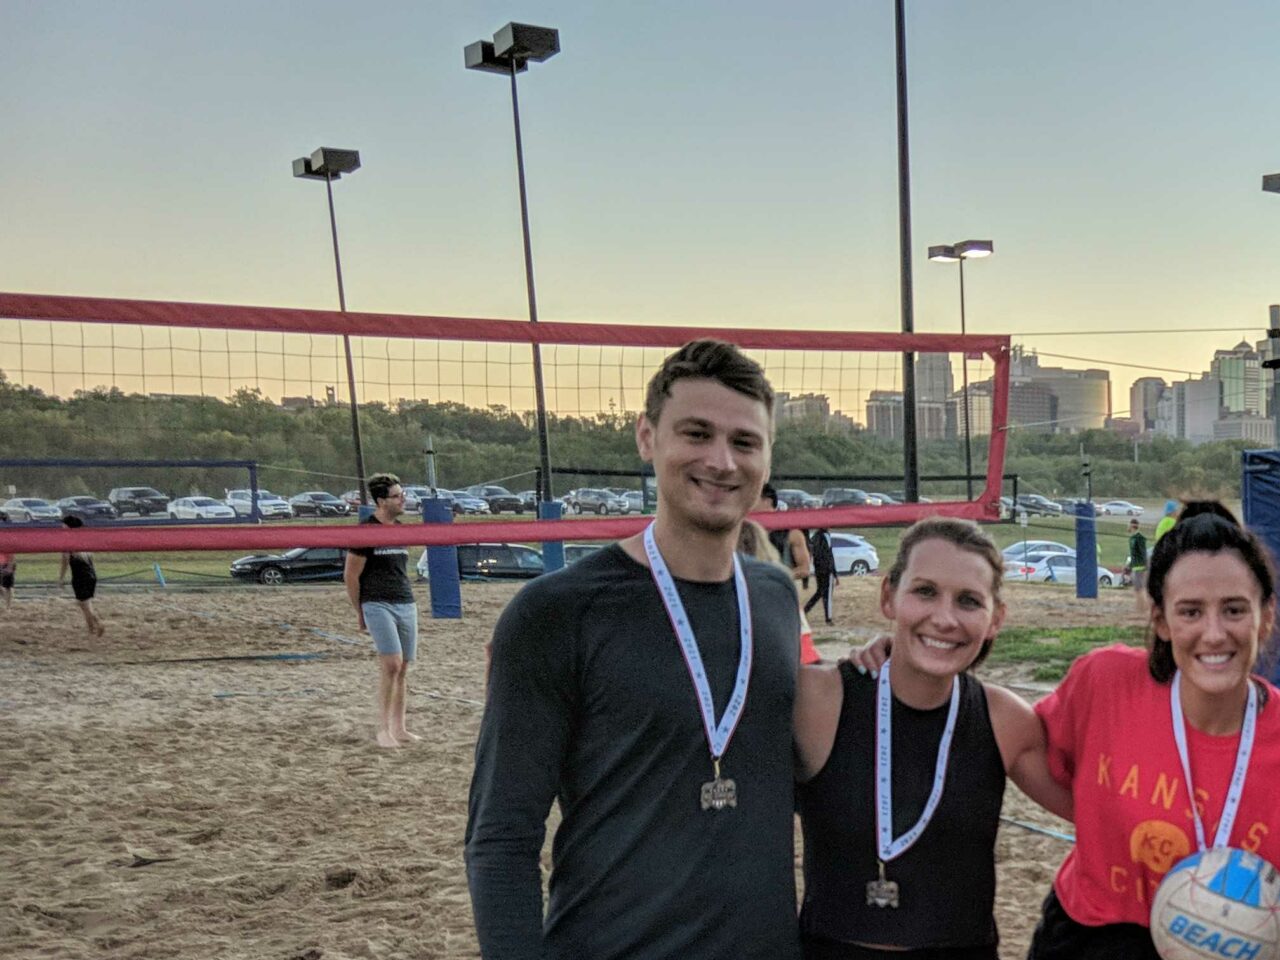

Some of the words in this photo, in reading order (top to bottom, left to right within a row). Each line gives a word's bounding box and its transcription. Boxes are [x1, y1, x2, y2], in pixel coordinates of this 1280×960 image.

[1097, 753, 1269, 852] KANSS
[1141, 831, 1173, 856] KC
[1110, 865, 1158, 904] CI
